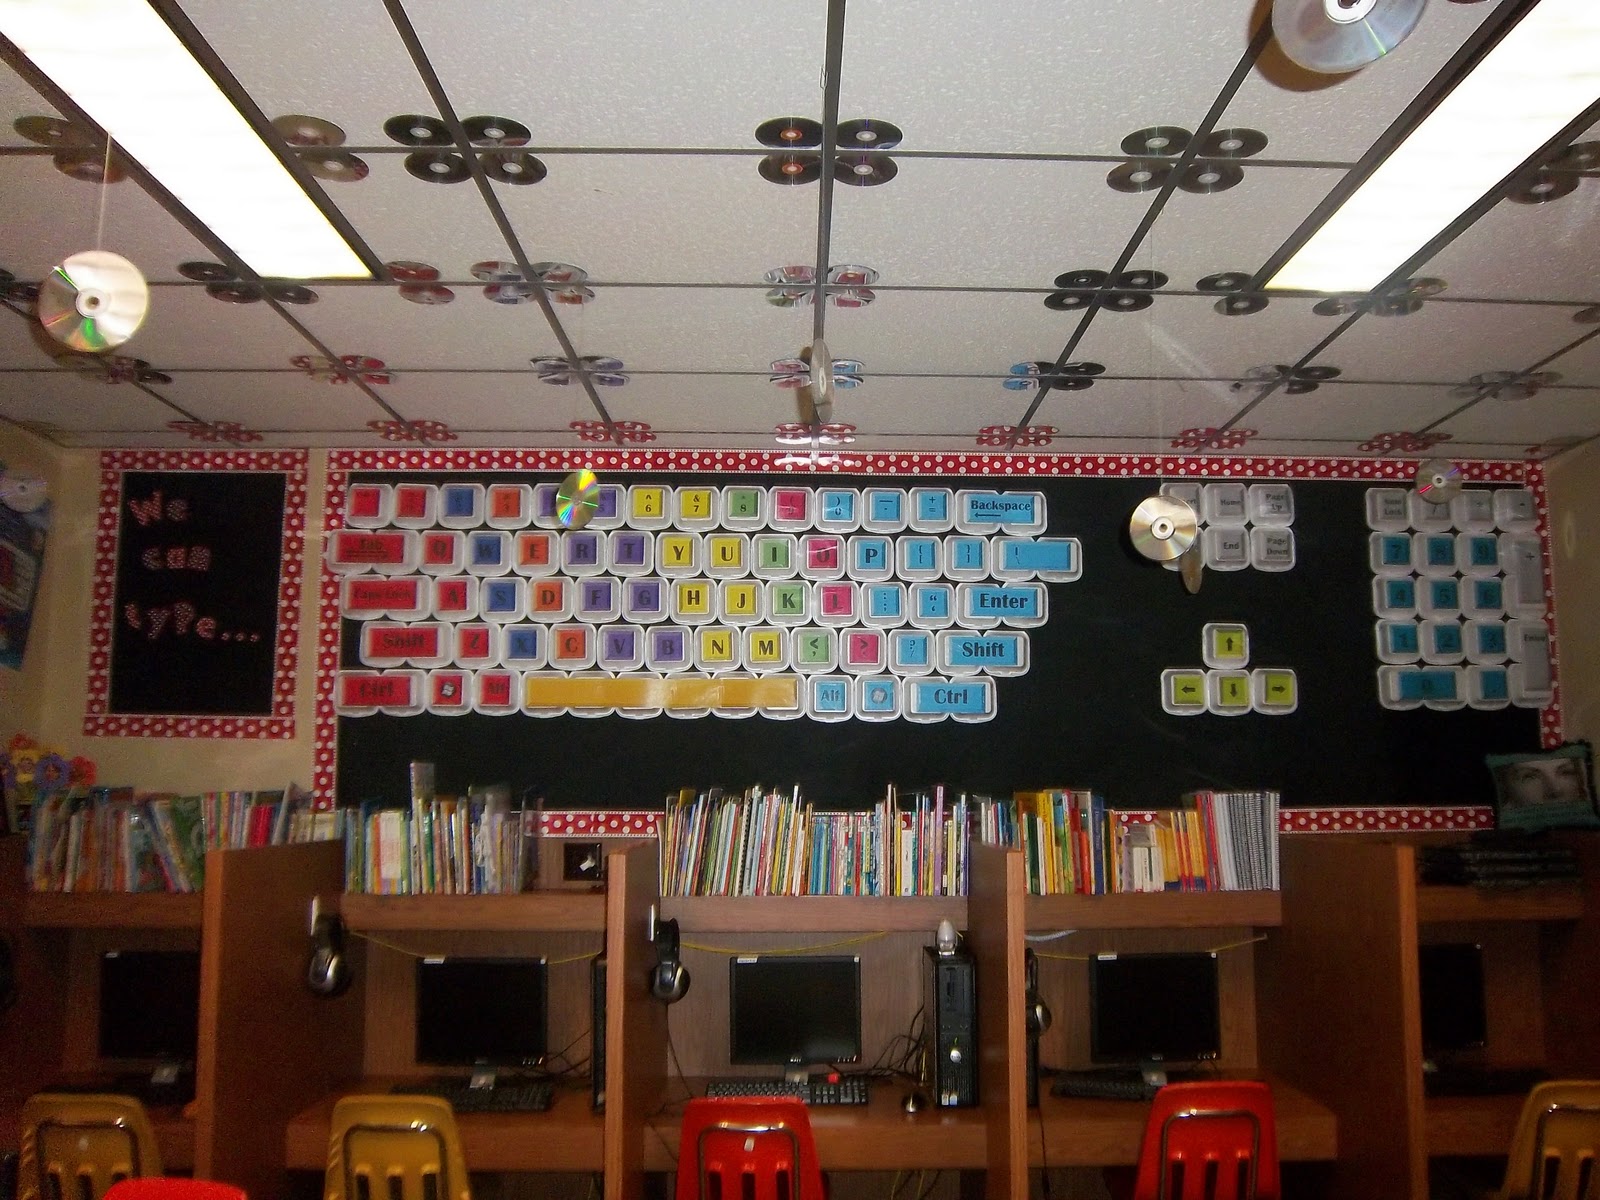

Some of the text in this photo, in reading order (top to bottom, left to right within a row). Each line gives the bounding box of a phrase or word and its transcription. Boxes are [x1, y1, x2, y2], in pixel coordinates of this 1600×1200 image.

[970, 500, 1031, 512] Backspace
[529, 543, 540, 559] E
[575, 543, 588, 558] R
[624, 543, 634, 558] T
[672, 545, 685, 561] Y
[721, 546, 733, 561] U
[771, 546, 778, 562] I
[865, 548, 878, 563] P
[541, 589, 555, 605] D
[591, 589, 601, 605] F
[637, 589, 650, 605] G
[687, 590, 700, 605] H
[736, 593, 746, 608] J
[782, 593, 796, 608] K
[979, 593, 1029, 609] Enter
[564, 637, 578, 653] C
[613, 638, 625, 654] V
[661, 639, 674, 655] B
[711, 639, 724, 655] N
[758, 640, 774, 656] M
[961, 641, 1005, 658] Shift
[820, 689, 841, 702] Alt
[934, 688, 968, 705] Ctrl
